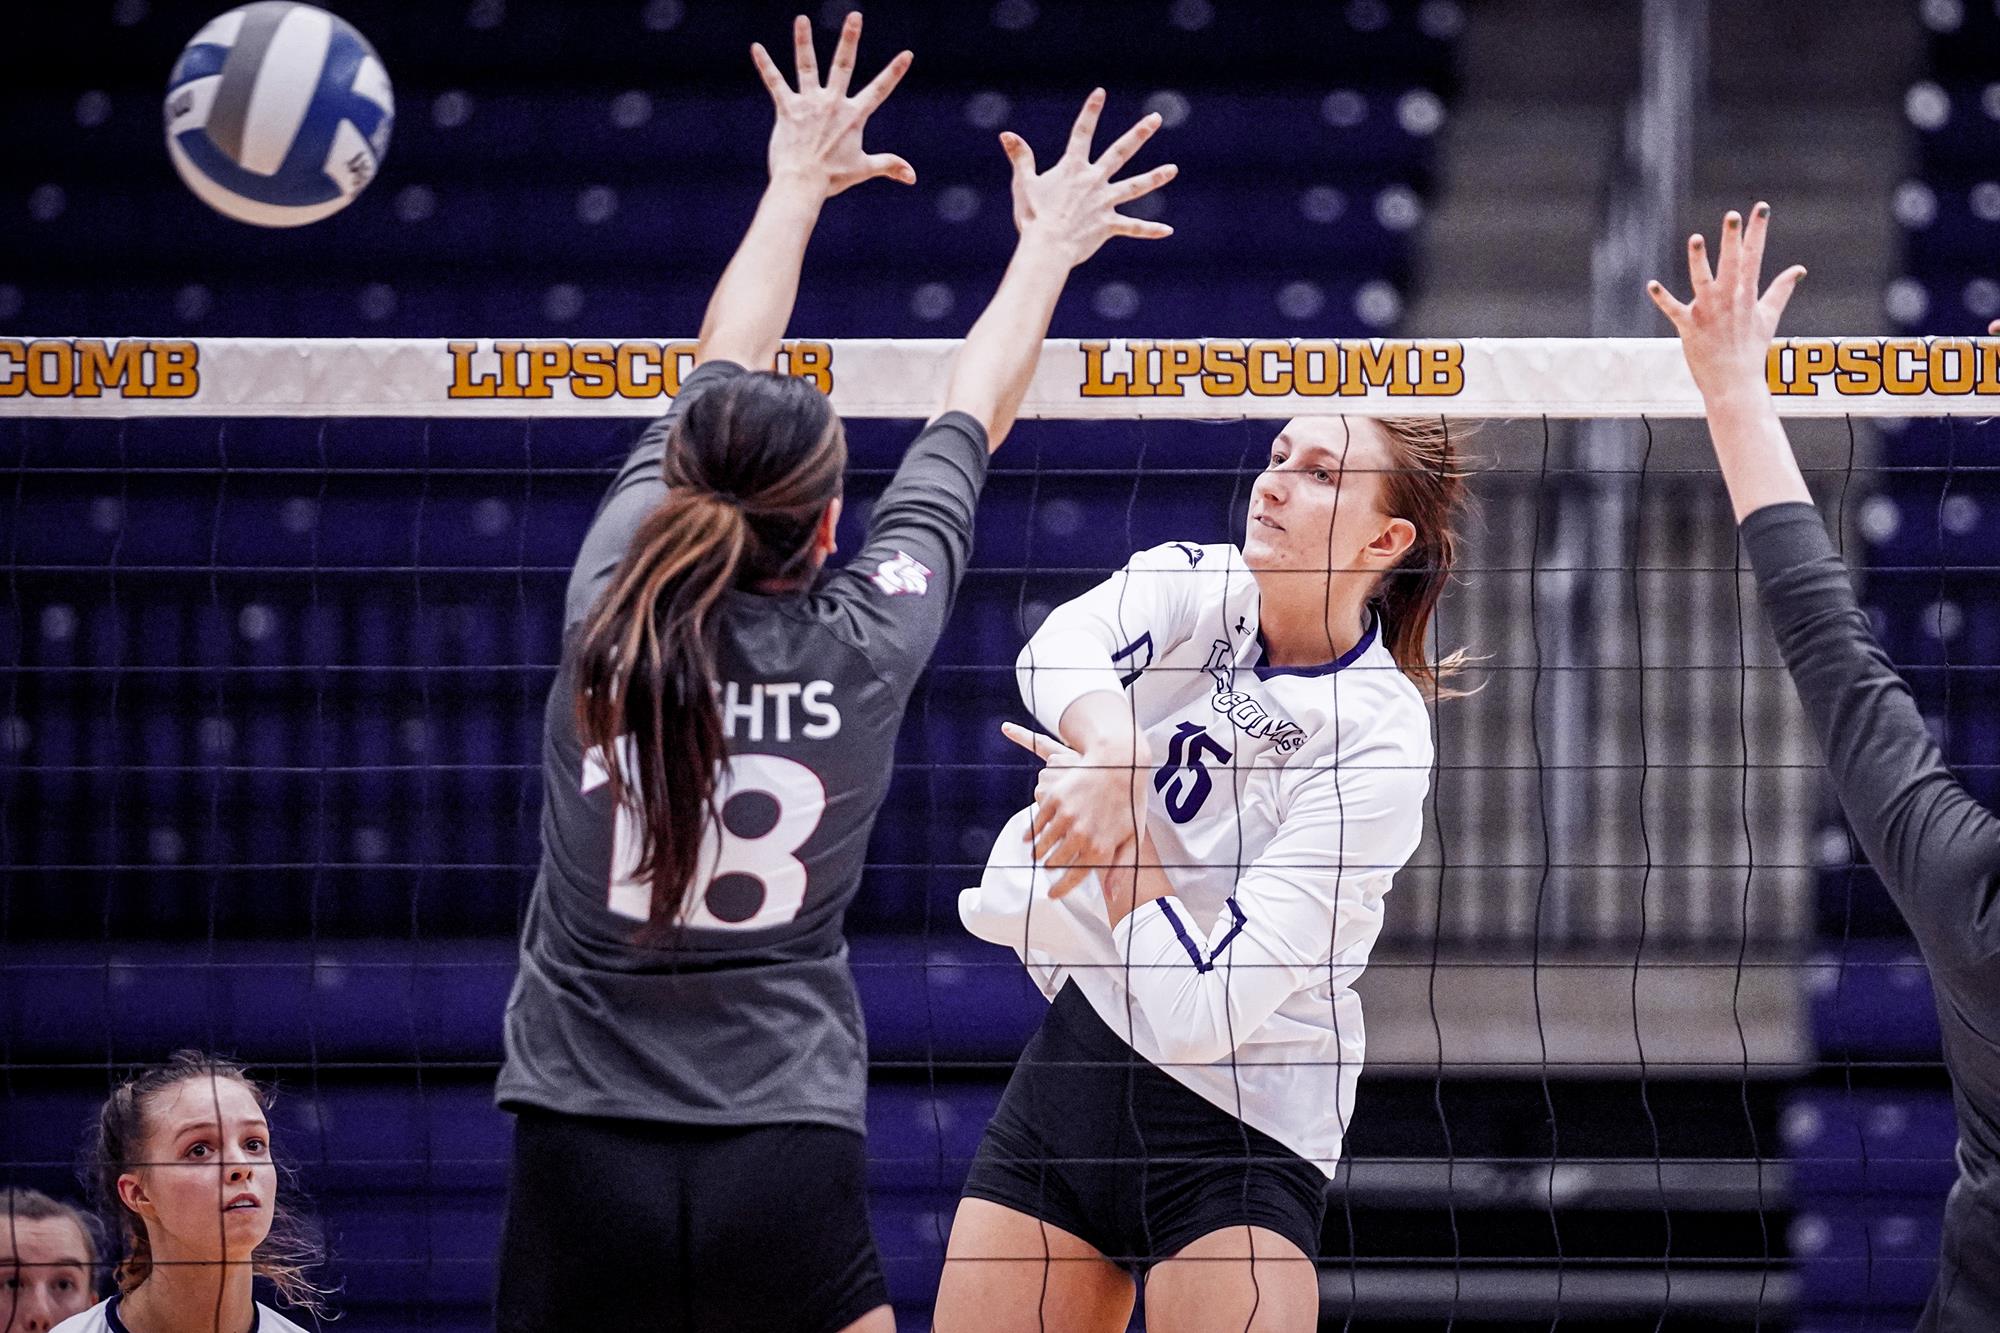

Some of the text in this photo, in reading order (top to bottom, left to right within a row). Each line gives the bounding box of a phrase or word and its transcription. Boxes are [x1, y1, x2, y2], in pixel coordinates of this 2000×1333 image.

[447, 341, 834, 399] LIPSCOB
[1079, 339, 1465, 397] LIPSCOMB
[1765, 338, 2000, 396] IPSCO
[1154, 721, 1233, 824] 15
[580, 753, 828, 932] 18
